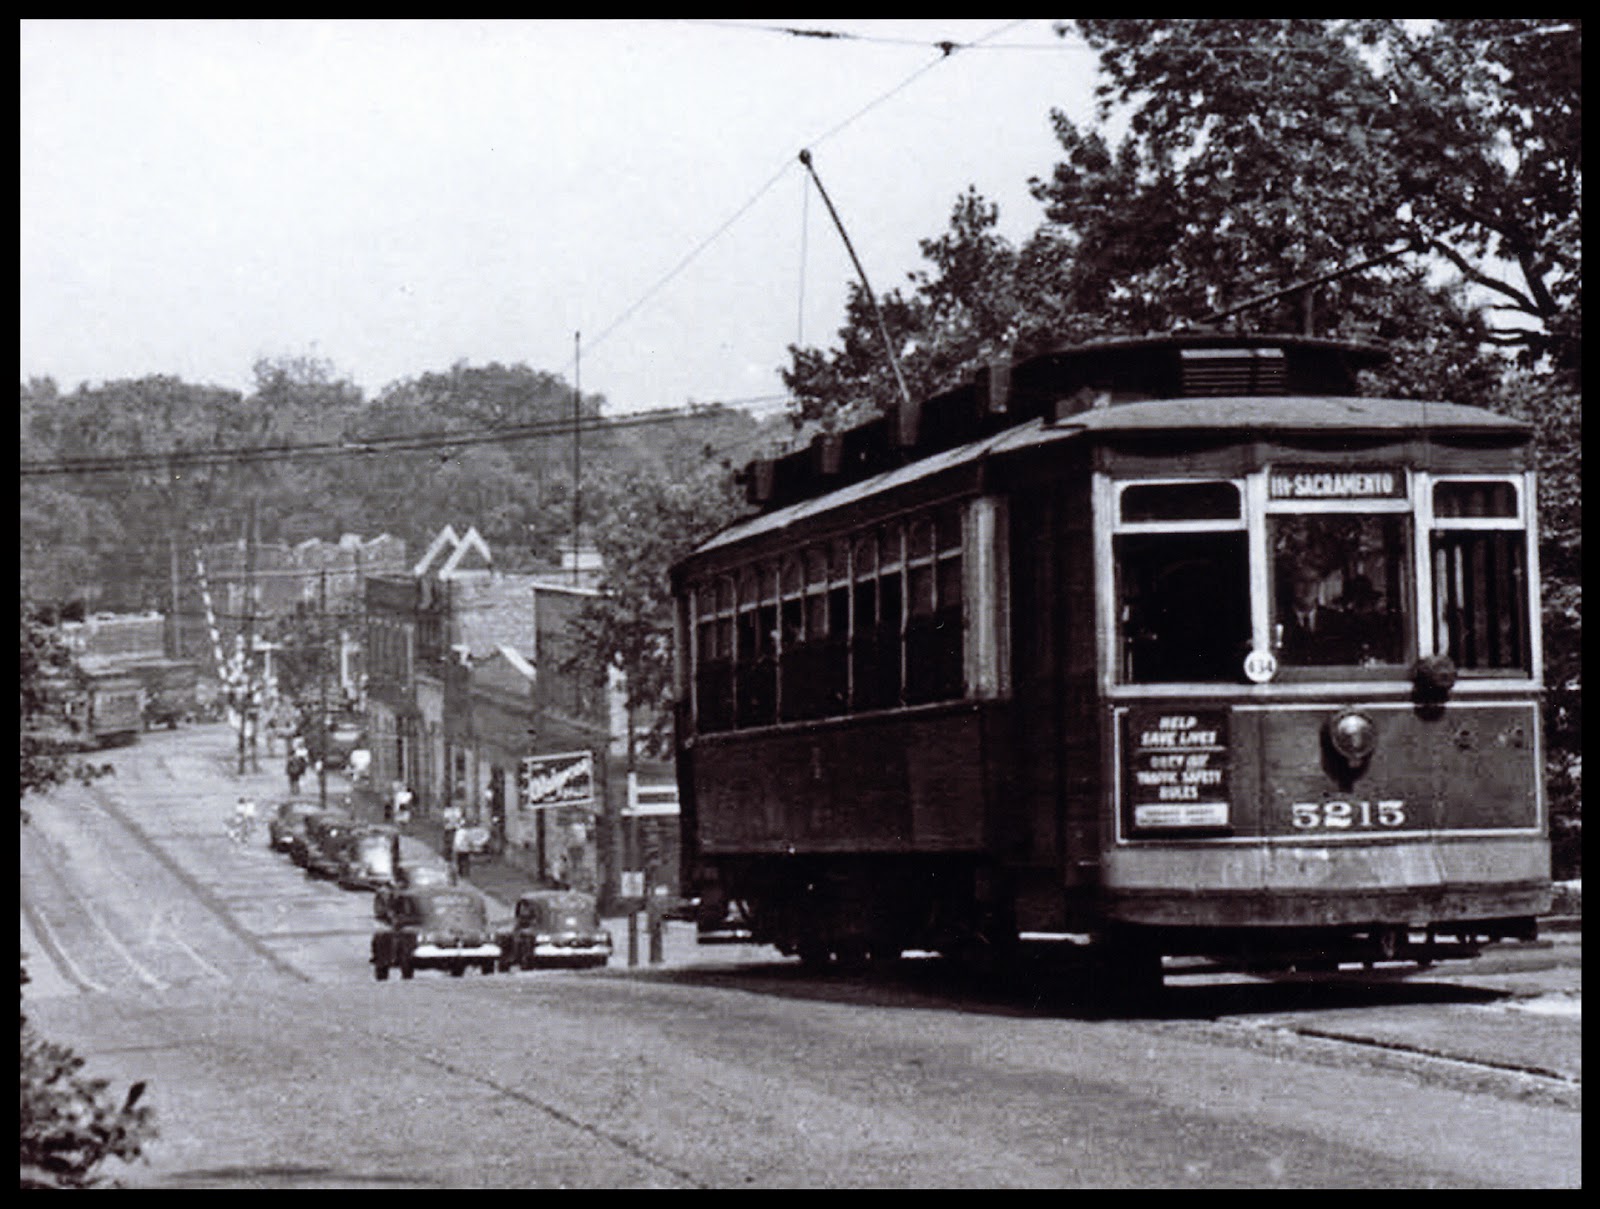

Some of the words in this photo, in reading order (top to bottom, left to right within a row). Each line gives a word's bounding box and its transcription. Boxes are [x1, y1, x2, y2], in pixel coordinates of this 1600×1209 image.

[1159, 716, 1197, 729] HELP
[1141, 731, 1176, 746] SAVE
[1180, 730, 1217, 745] LIVES
[1181, 769, 1222, 785] SAFETY
[1159, 786, 1198, 801] RULES
[1291, 800, 1405, 829] 5215
